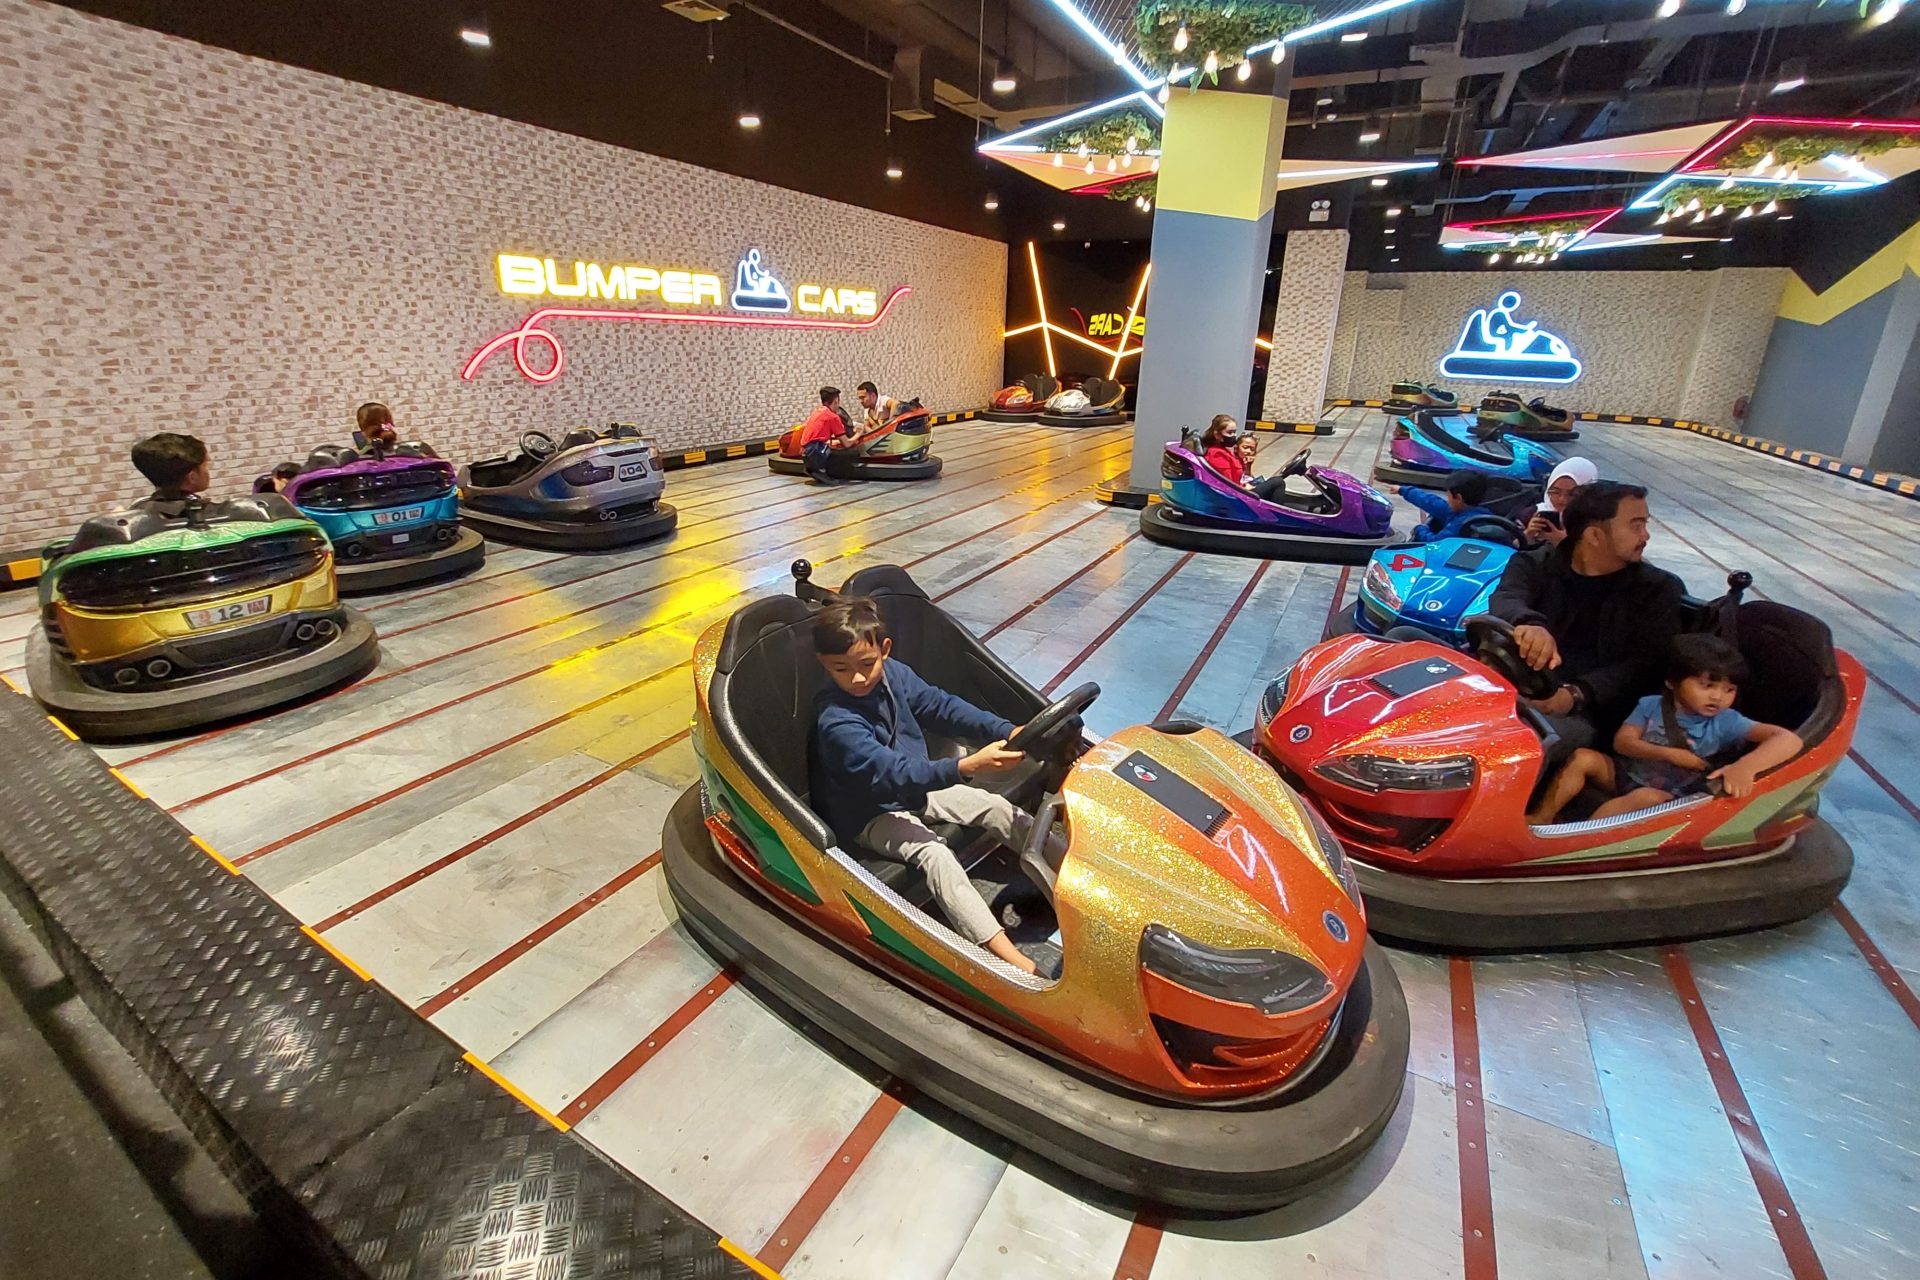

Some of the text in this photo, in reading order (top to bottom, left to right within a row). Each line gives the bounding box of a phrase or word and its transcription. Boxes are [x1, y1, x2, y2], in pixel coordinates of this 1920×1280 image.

[498, 254, 877, 316] BUMPER CARS
[627, 465, 642, 475] 04
[392, 511, 407, 521] 01
[1387, 554, 1425, 572] 4
[218, 604, 244, 621] 12
